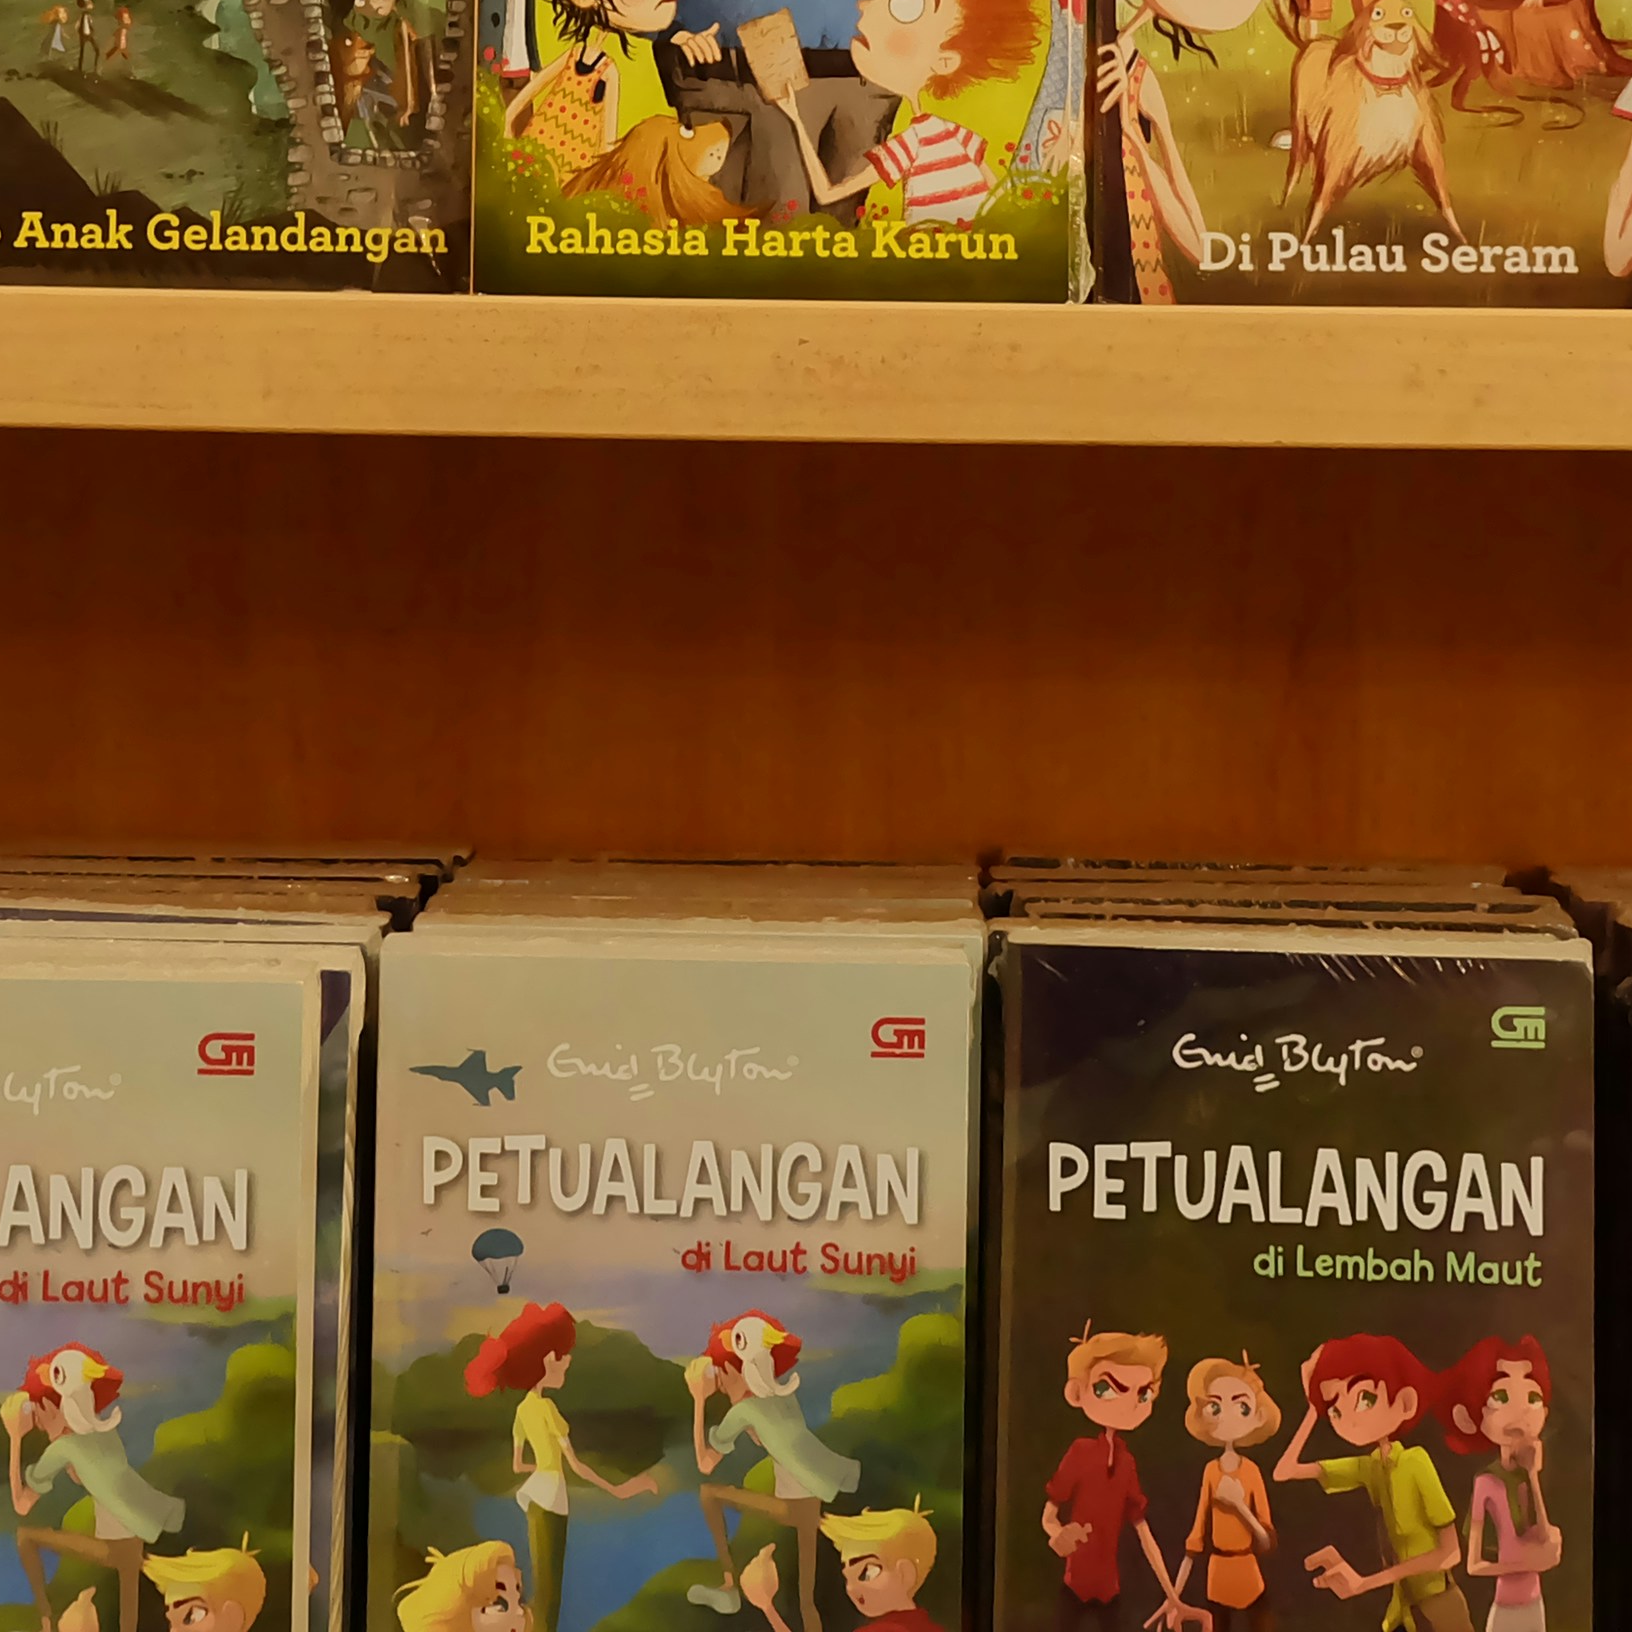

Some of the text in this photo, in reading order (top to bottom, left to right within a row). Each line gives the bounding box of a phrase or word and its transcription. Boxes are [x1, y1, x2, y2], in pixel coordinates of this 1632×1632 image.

[14, 208, 133, 249] Anak
[146, 209, 448, 263] Gelandangan
[525, 212, 1019, 261] Rahasia Harta Karun
[1198, 227, 1579, 275] Di Pulau Seram
[547, 1043, 639, 1081] Enid
[1172, 1032, 1265, 1072] Enid
[421, 1133, 919, 1225] PETUALANGAN
[1048, 1141, 1544, 1236] PETUALANGAN
[680, 1240, 917, 1283] di Laut Sunyi
[1253, 1244, 1543, 1288] di Lembah Maut
[41, 1270, 130, 1305] Laut
[143, 1271, 245, 1312] Sunyi
